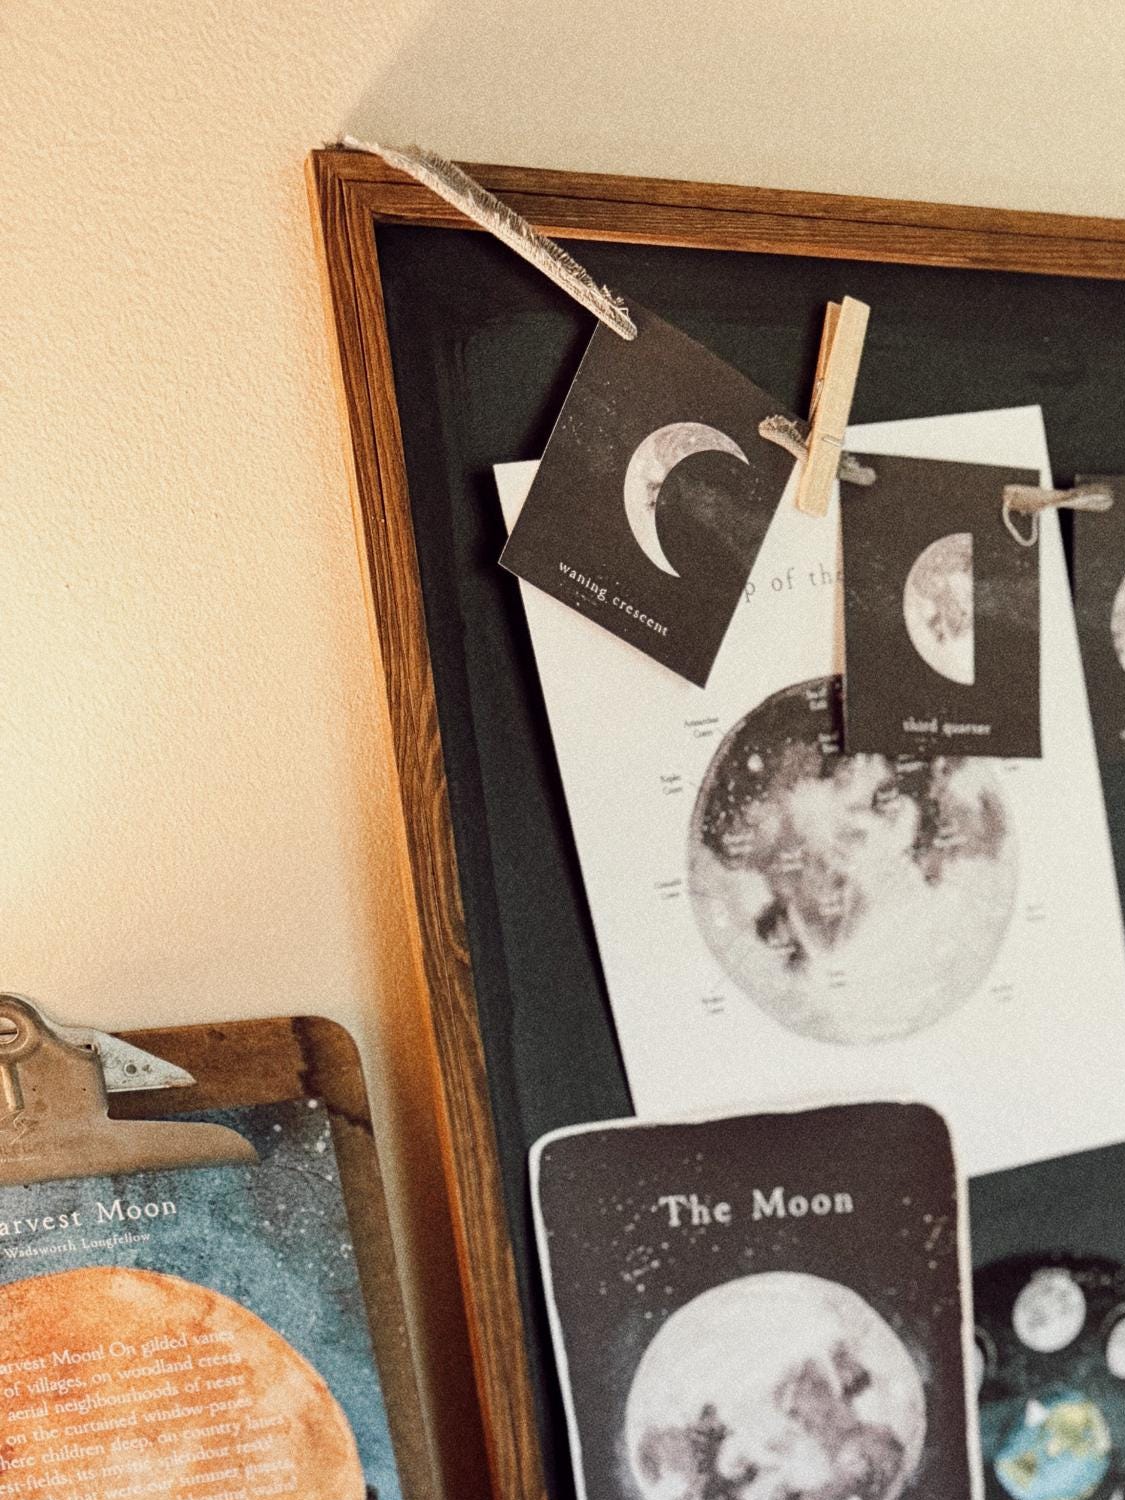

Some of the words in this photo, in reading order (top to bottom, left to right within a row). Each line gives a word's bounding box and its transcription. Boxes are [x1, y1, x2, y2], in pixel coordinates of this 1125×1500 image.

[772, 567, 794, 592] of
[560, 562, 607, 601] waning
[612, 597, 668, 636] crescent
[903, 716, 938, 733] third
[942, 723, 991, 737] quarter
[97, 1199, 177, 1223] Moon
[658, 1194, 731, 1227] The
[752, 1186, 854, 1221] Moon
[4, 1240, 77, 1259] Wadsworth
[82, 1232, 151, 1250] Longfellow
[51, 1344, 104, 1366] Moon!
[109, 1341, 136, 1358] On
[140, 1332, 188, 1357] gilded
[4, 1381, 21, 1399] of
[27, 1376, 87, 1396] villages,
[91, 1372, 112, 1384] on
[118, 1355, 193, 1380] woodland
[8, 1400, 49, 1421] aerial
[55, 1381, 179, 1415] neighbourhoods
[184, 1376, 202, 1393] of
[6, 1433, 28, 1446] on
[32, 1426, 59, 1442] the
[64, 1410, 138, 1435] curtained
[42, 1443, 105, 1463] children
